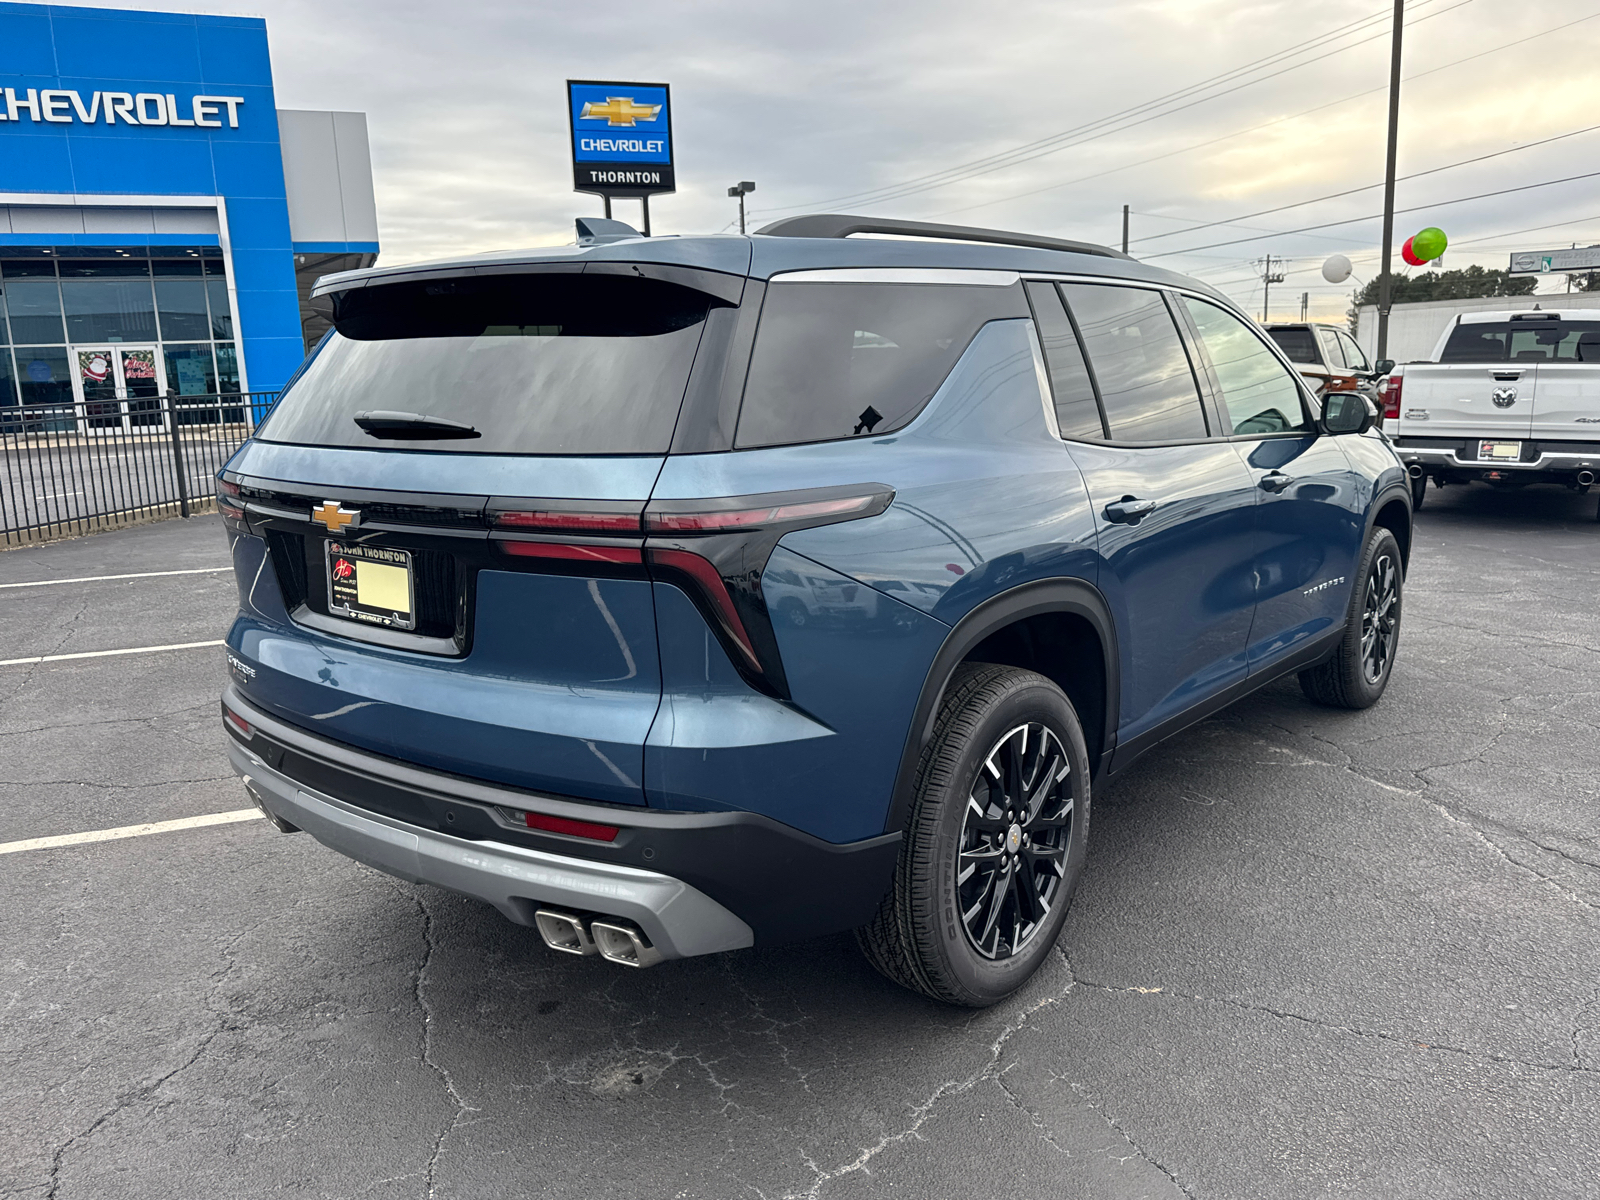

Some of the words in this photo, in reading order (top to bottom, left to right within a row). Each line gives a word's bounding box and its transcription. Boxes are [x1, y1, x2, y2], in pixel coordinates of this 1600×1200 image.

[0, 88, 244, 128] HEVROLET
[581, 139, 664, 152] CHEVROLET
[590, 171, 660, 183] THORNTON
[357, 613, 383, 623] CHEVROLET
